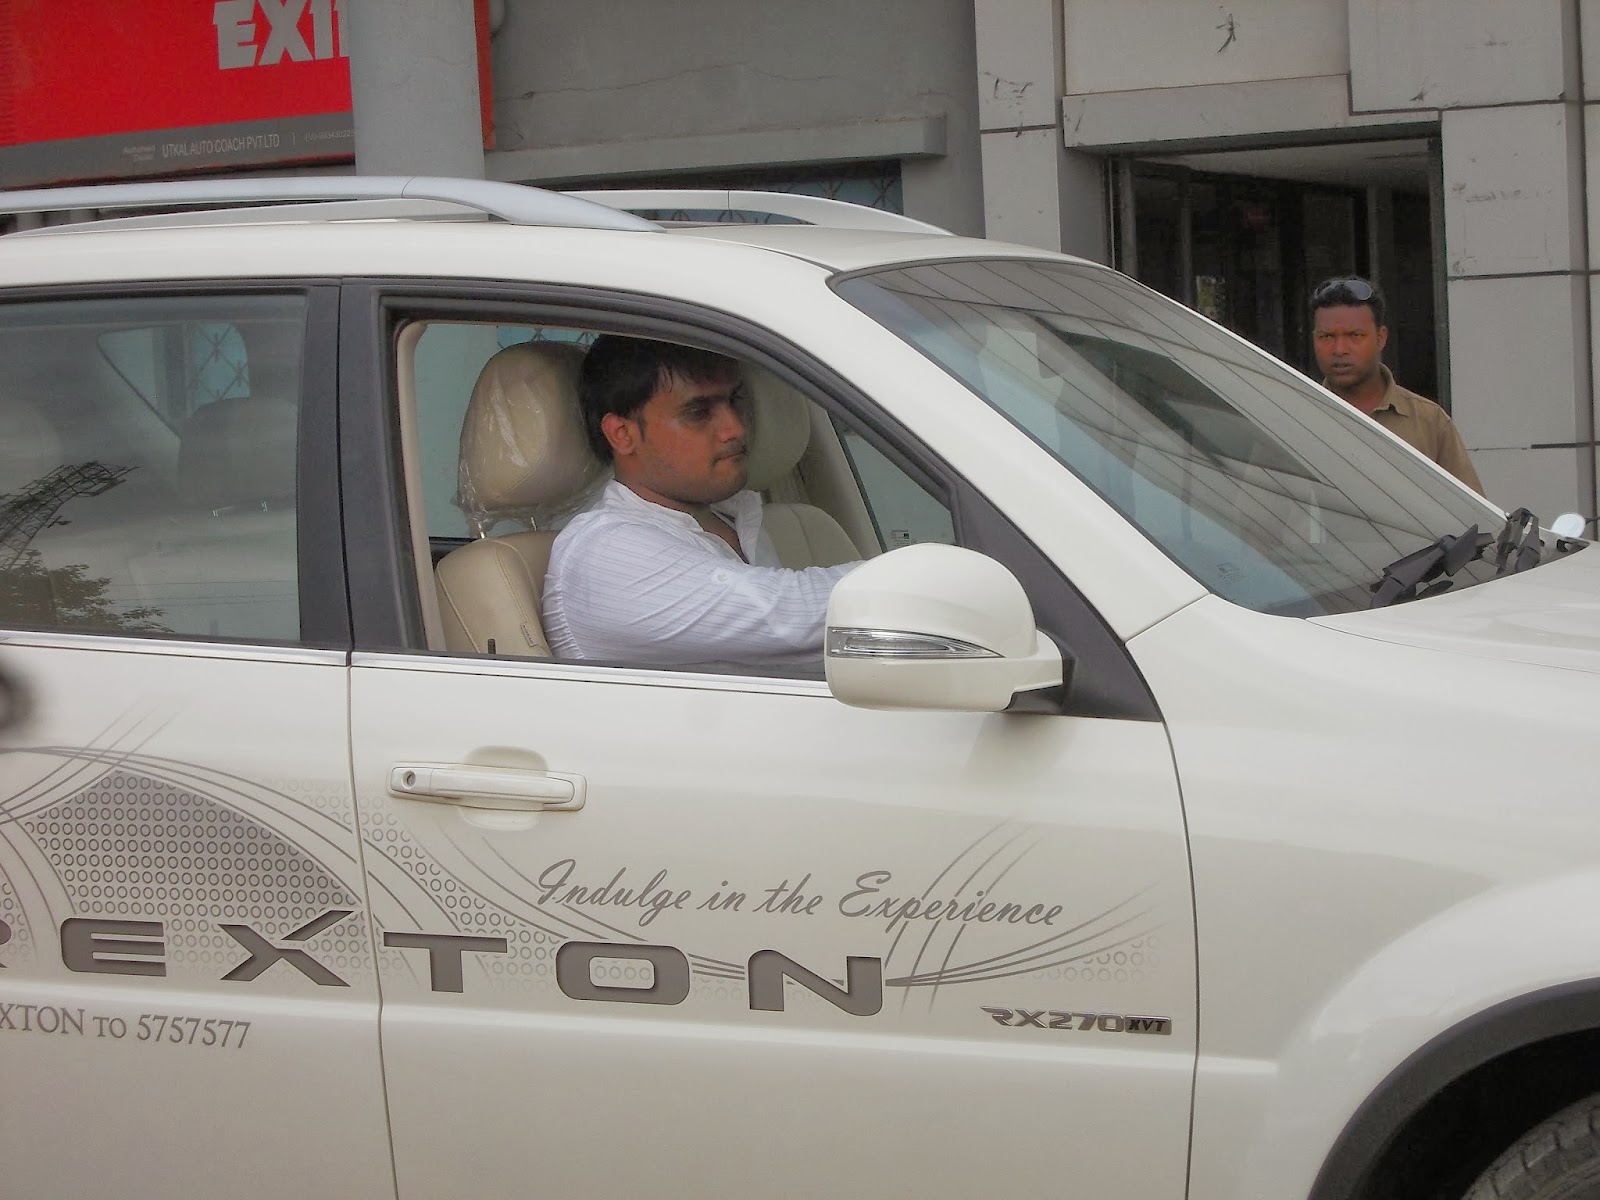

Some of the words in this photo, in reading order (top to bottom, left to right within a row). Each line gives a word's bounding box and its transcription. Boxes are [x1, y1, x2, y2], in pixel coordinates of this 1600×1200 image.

[162, 143, 189, 158] UTKAL
[190, 140, 213, 156] AUTO
[214, 137, 245, 154] COACH
[537, 858, 690, 925] Indulge
[697, 881, 747, 911] in
[755, 873, 823, 916] the
[839, 871, 1064, 933] Experience
[0, 909, 883, 1016] EXTON
[92, 1015, 127, 1039] TO
[137, 1012, 252, 1049] 5757577
[980, 1005, 1124, 1032] RX270
